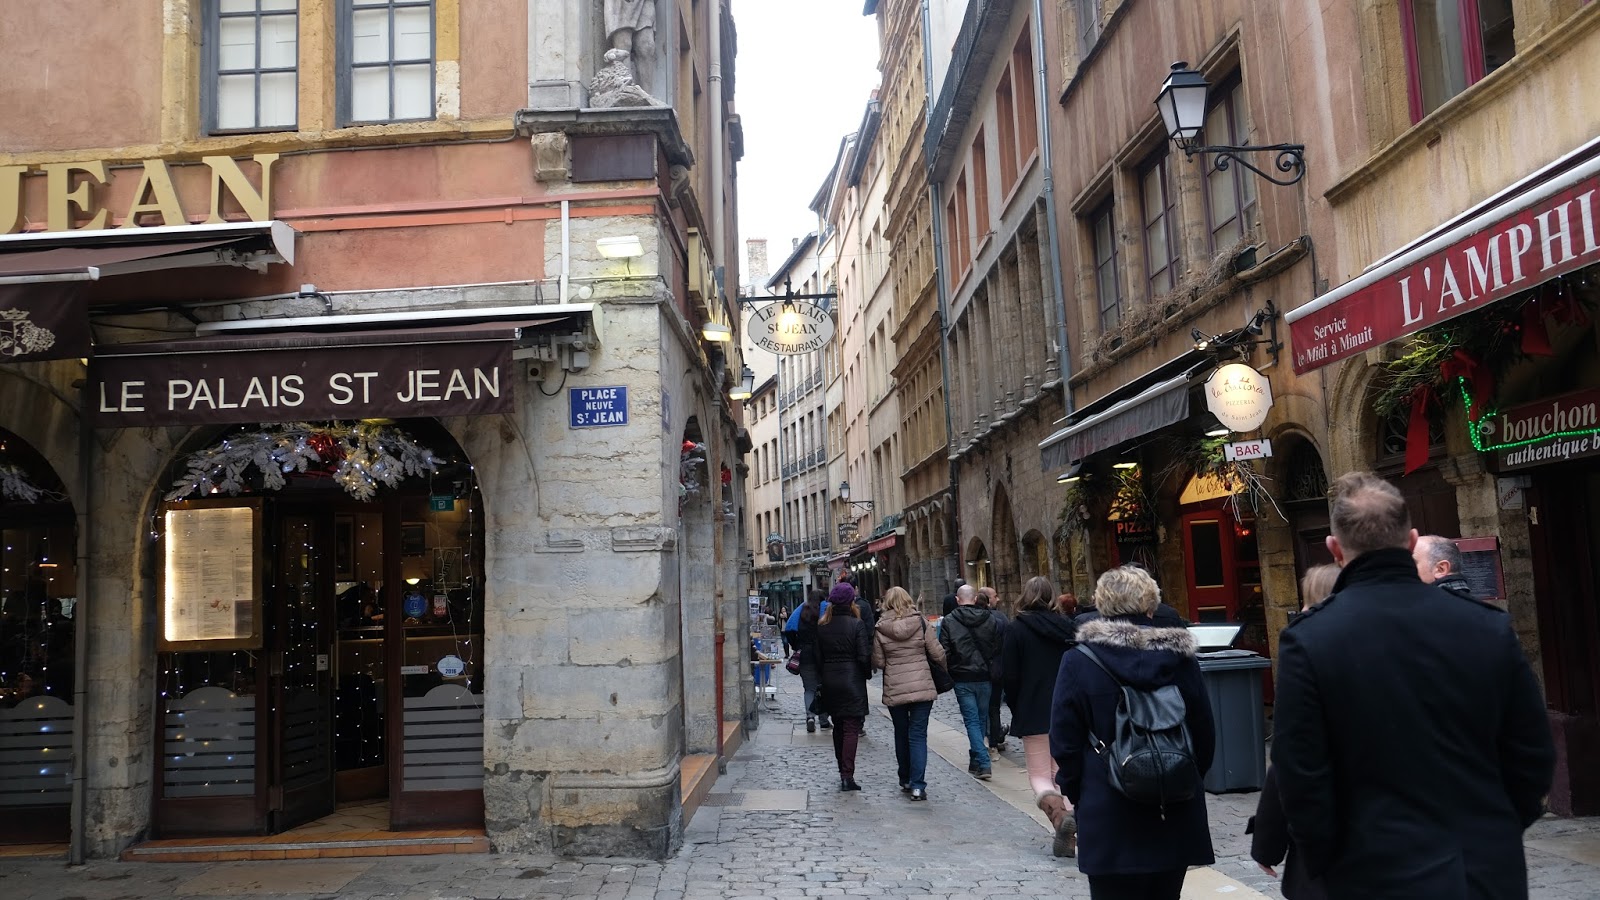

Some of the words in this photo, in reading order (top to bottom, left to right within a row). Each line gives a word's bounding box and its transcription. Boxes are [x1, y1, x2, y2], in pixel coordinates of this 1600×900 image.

[1398, 189, 1600, 327] L'AMPHI
[758, 307, 775, 322] LE
[781, 303, 827, 323] PALAIS
[785, 323, 818, 334] JEAN
[1314, 317, 1347, 341] Service
[760, 335, 824, 353] RESTAURANT
[1306, 342, 1328, 363] Midi
[1331, 340, 1337, 355] à
[1339, 326, 1373, 352] Minuit
[100, 381, 145, 412] LE
[168, 374, 305, 410] PALAIS
[328, 371, 379, 405] ST
[396, 366, 500, 402] JEAN
[581, 388, 617, 400] PLACE
[585, 401, 614, 411] NEUVE
[592, 411, 624, 424] JEAN
[1502, 401, 1598, 443] bouchon
[1235, 444, 1261, 457] BAR
[1506, 438, 1588, 466] authentique
